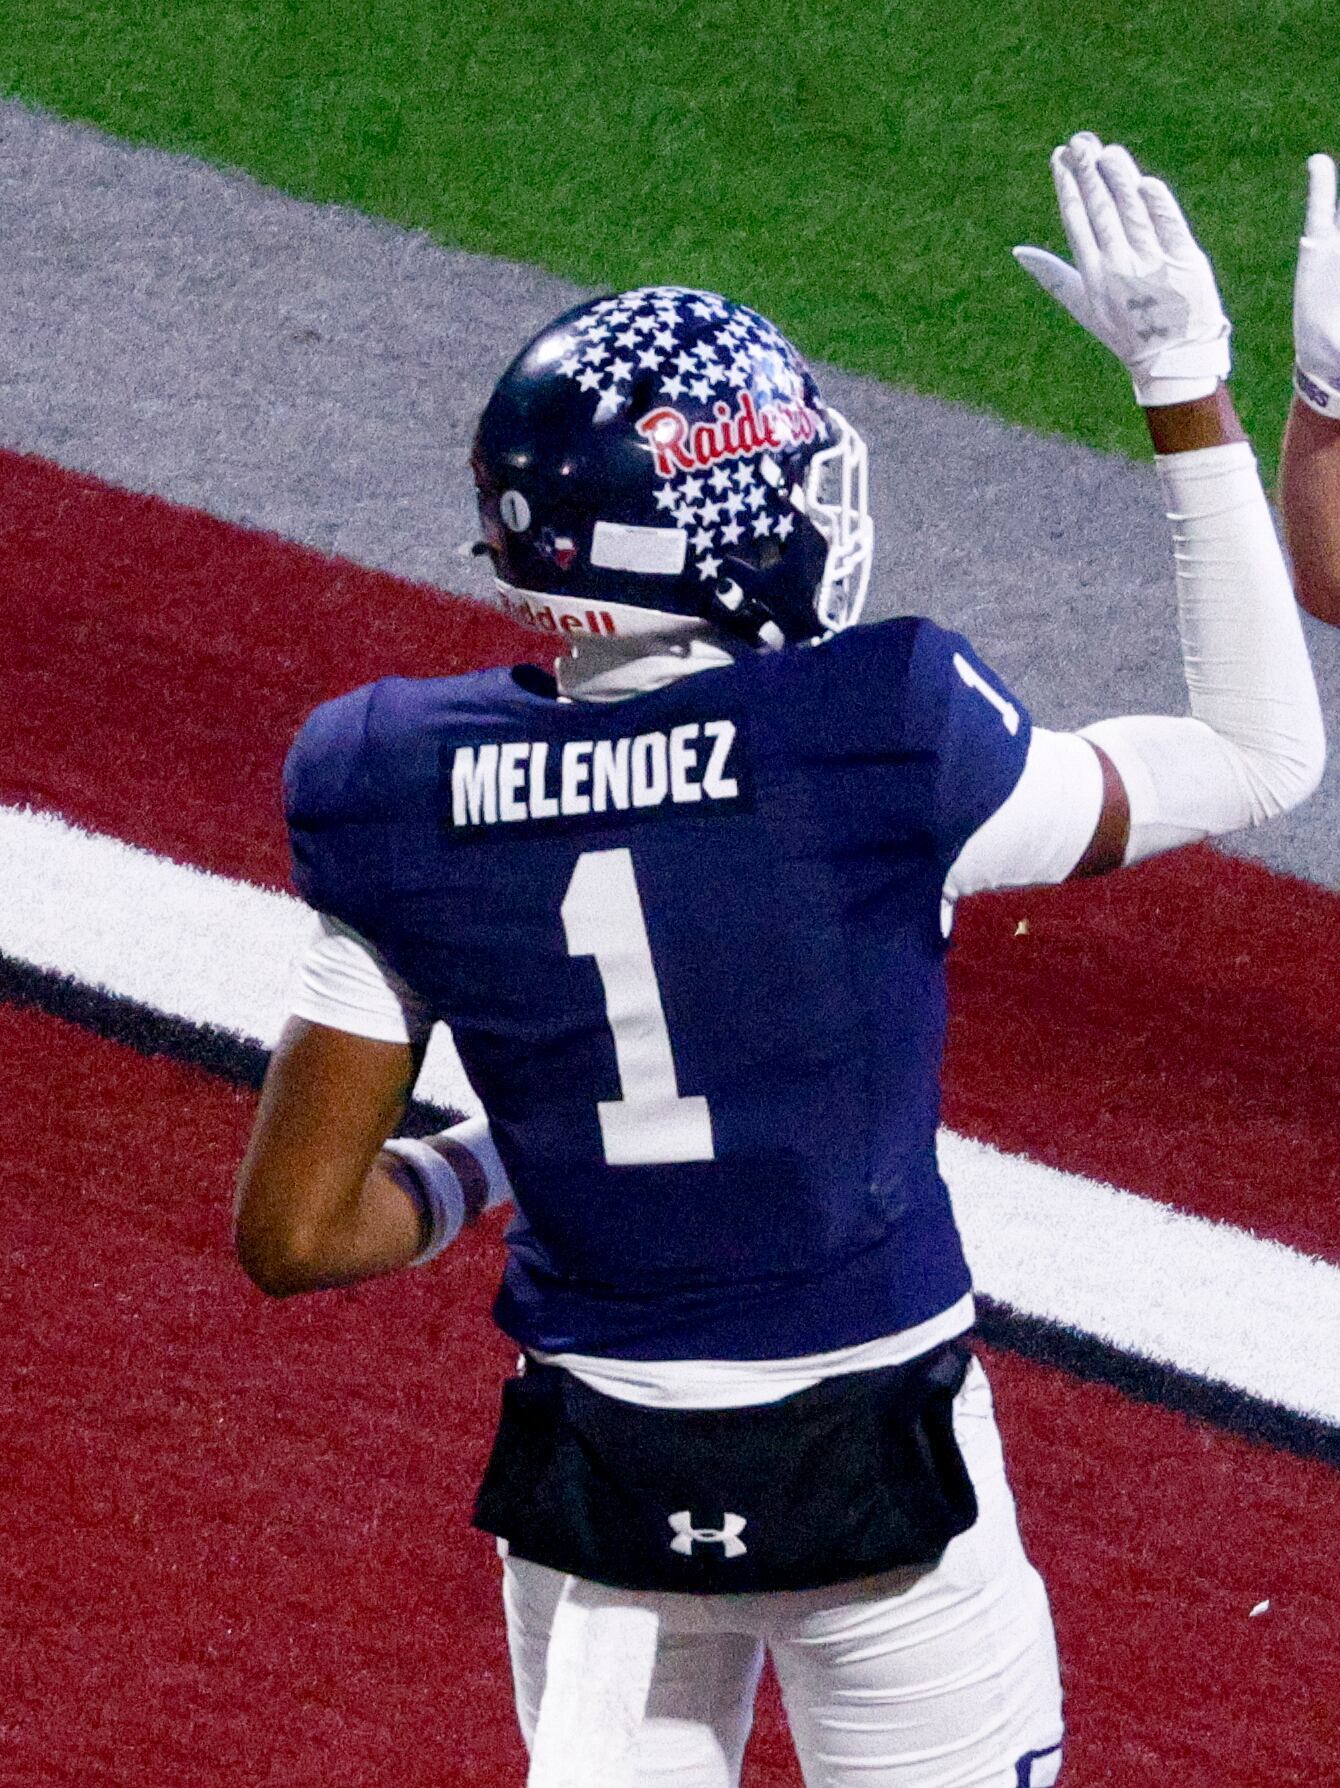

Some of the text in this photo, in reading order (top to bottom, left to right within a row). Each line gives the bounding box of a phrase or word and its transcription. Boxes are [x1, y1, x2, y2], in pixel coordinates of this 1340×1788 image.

[635, 388, 817, 479] Raiders
[953, 652, 1020, 736] 1
[452, 719, 739, 827] MELENDEZ
[561, 847, 715, 1165] 1
